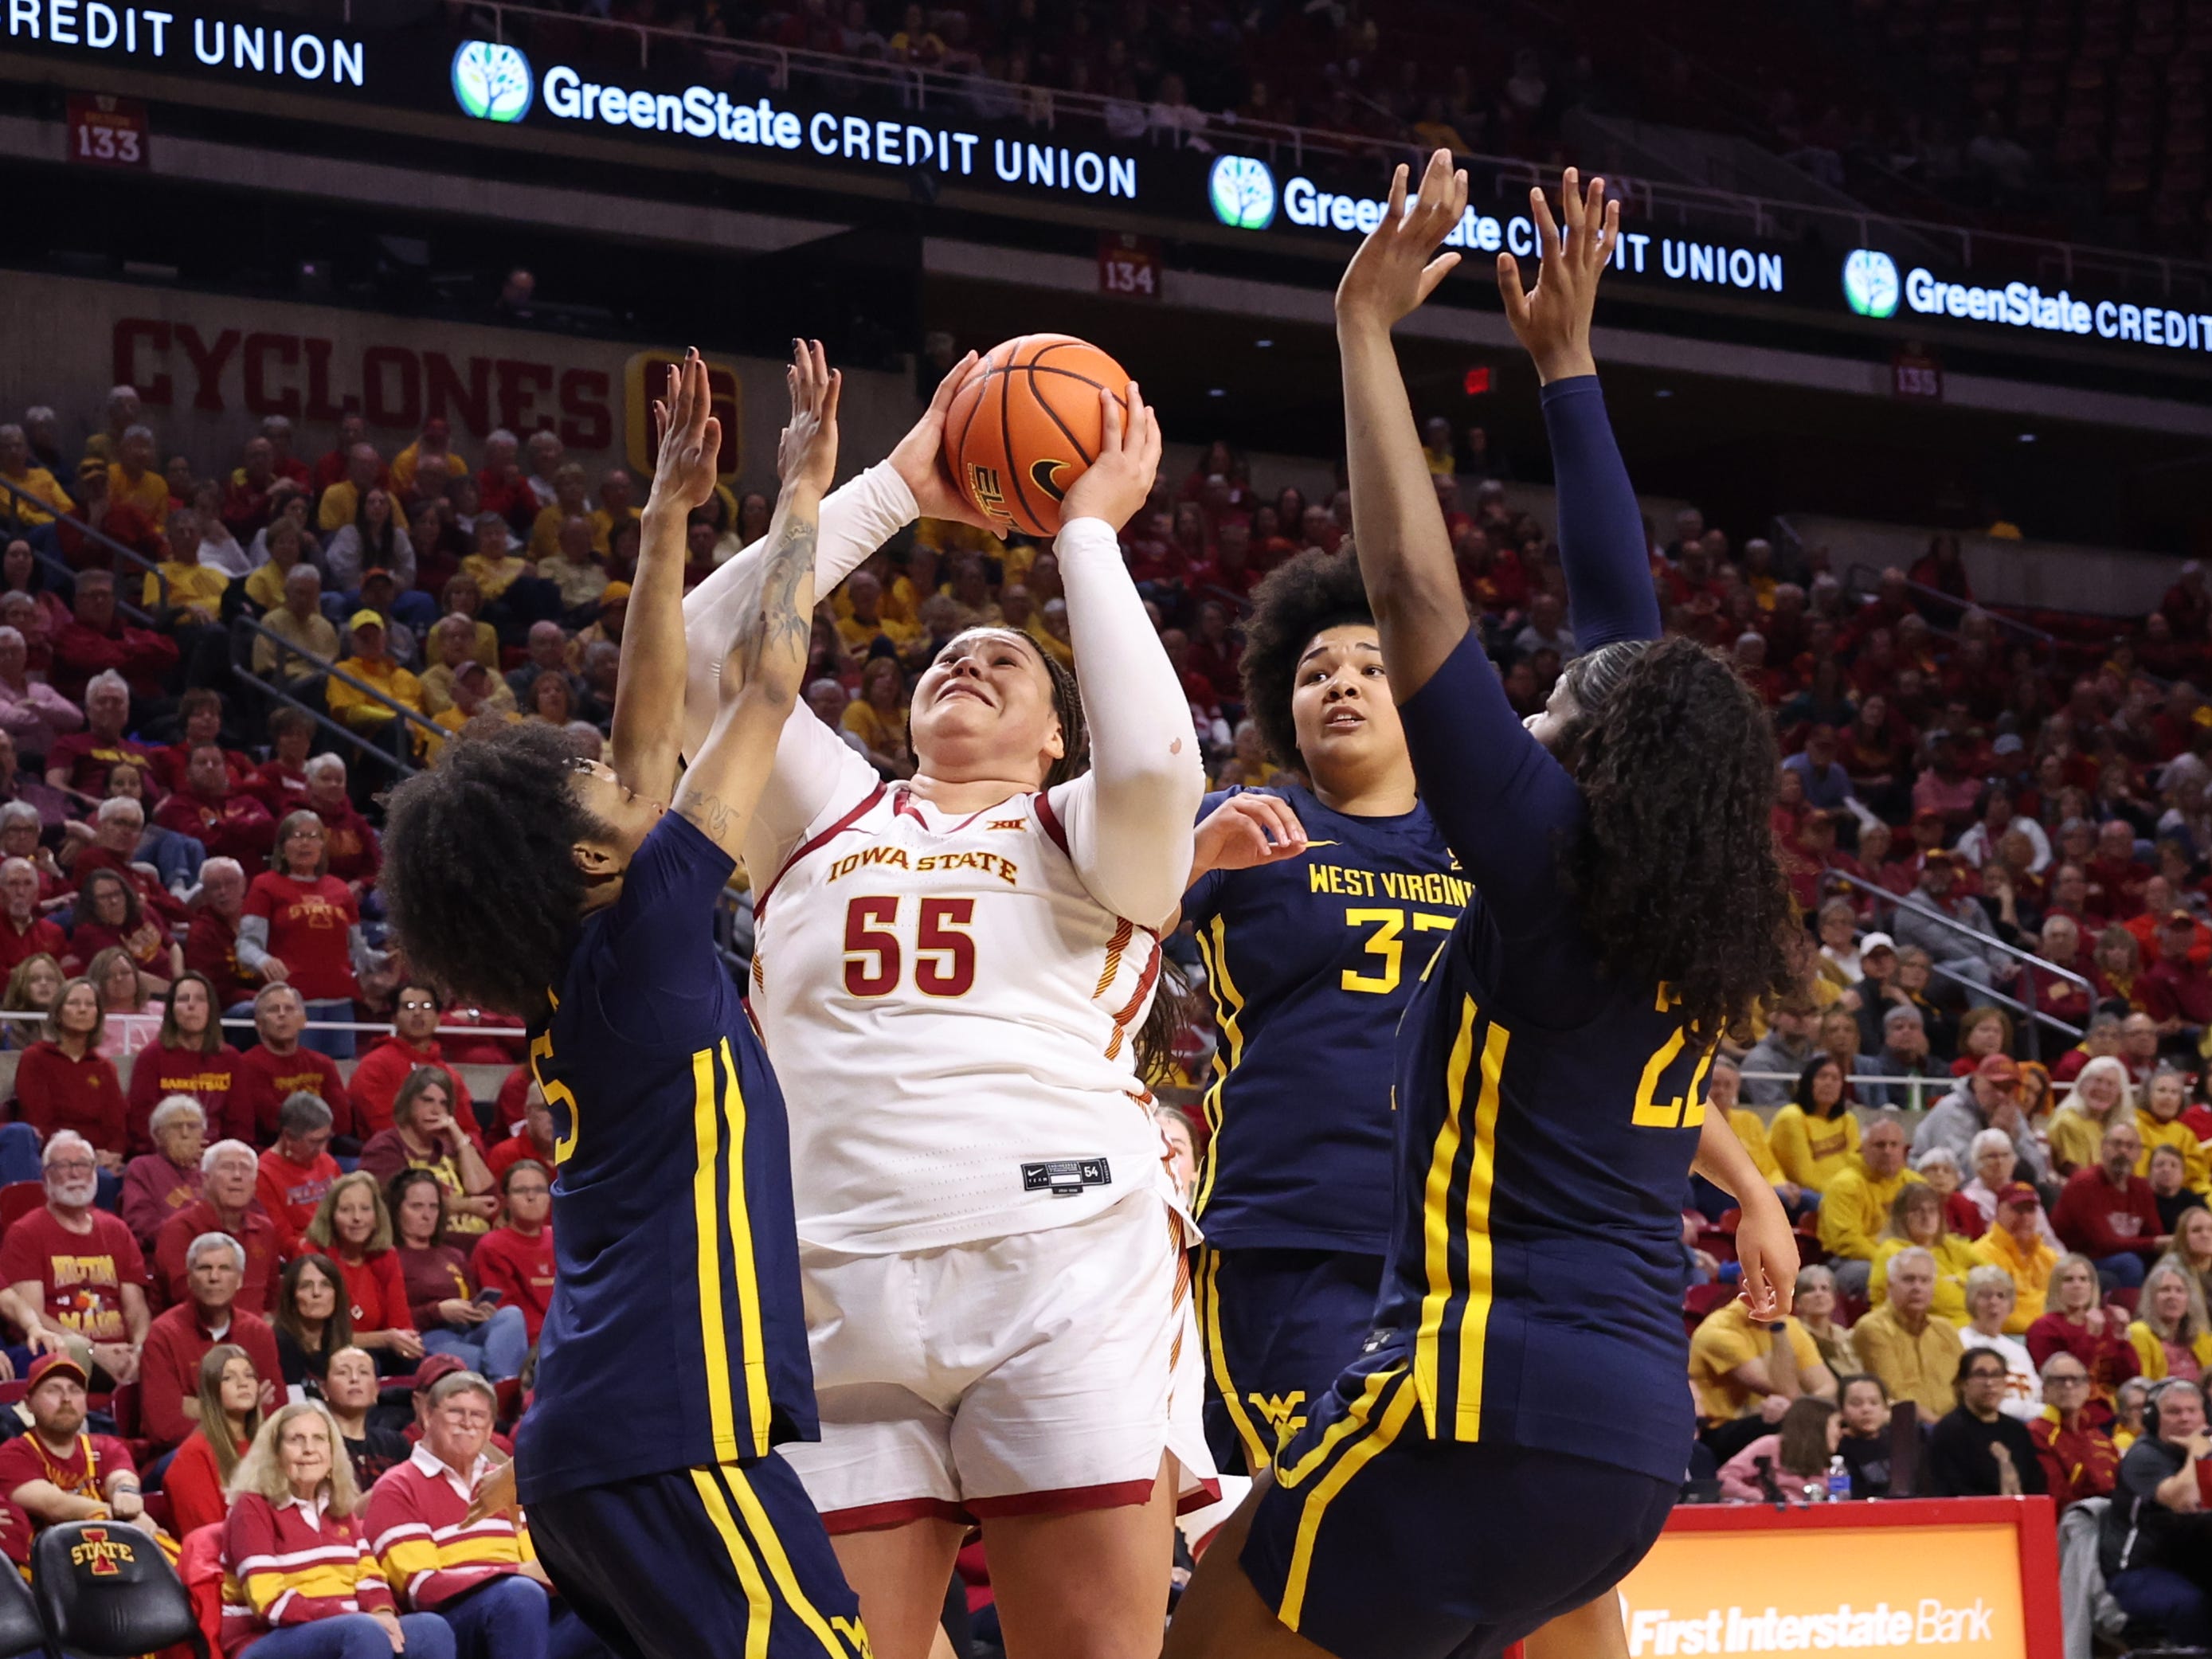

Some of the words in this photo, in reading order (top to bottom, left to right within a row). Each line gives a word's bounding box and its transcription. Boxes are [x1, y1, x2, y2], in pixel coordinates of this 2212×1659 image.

[0, 0, 173, 57] REDIT
[194, 18, 364, 87] UNION
[77, 124, 140, 163] 133
[542, 66, 801, 151] GreenState
[809, 112, 979, 174] CREDIT
[995, 139, 1137, 199] UNION
[1106, 260, 1154, 295] 134
[1663, 238, 1783, 293] UNION
[1906, 267, 2092, 335] GreenState
[2095, 300, 2212, 353] CREDIT
[113, 318, 613, 449] CYCLONES
[827, 846, 909, 885] IOWA
[917, 851, 1019, 886] STATE
[1309, 863, 1376, 898] WEST
[843, 895, 976, 1000] 55
[1084, 1166, 1099, 1178] 54
[71, 1540, 135, 1566] STATE
[1629, 1608, 1722, 1657] First
[1724, 1602, 1913, 1653] Interstate
[1915, 1597, 1995, 1645] Bank
